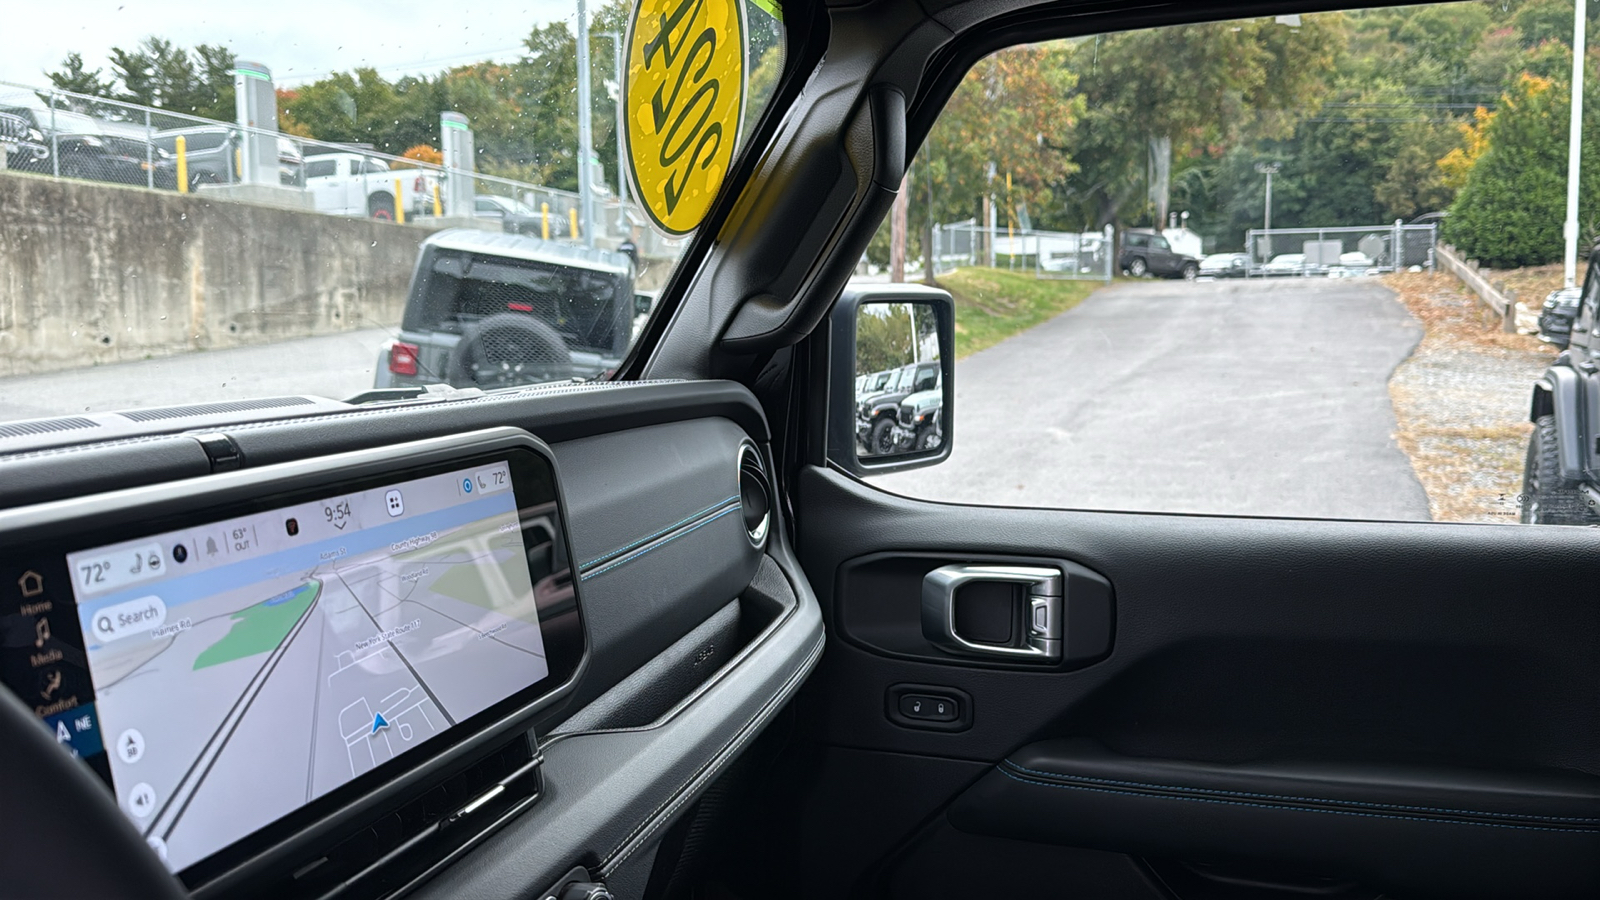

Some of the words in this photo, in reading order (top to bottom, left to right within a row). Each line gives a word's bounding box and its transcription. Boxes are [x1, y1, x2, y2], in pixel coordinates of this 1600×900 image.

[492, 471, 506, 485] 72°
[325, 503, 351, 522] 9:54
[232, 528, 247, 540] 63°
[234, 541, 250, 552] OUT
[391, 542, 409, 551] County
[410, 535, 431, 546] Highway
[320, 551, 340, 560] Adams
[81, 562, 111, 585] 72°
[20, 601, 52, 616] Home
[118, 606, 158, 627] Search
[152, 625, 179, 638] Haines
[180, 620, 192, 629] Rd
[356, 641, 368, 650] New
[369, 637, 381, 645] York
[381, 632, 395, 640] State
[395, 626, 410, 635] Route
[411, 620, 420, 628] 117
[31, 651, 63, 667] Media
[75, 715, 92, 732] NE
